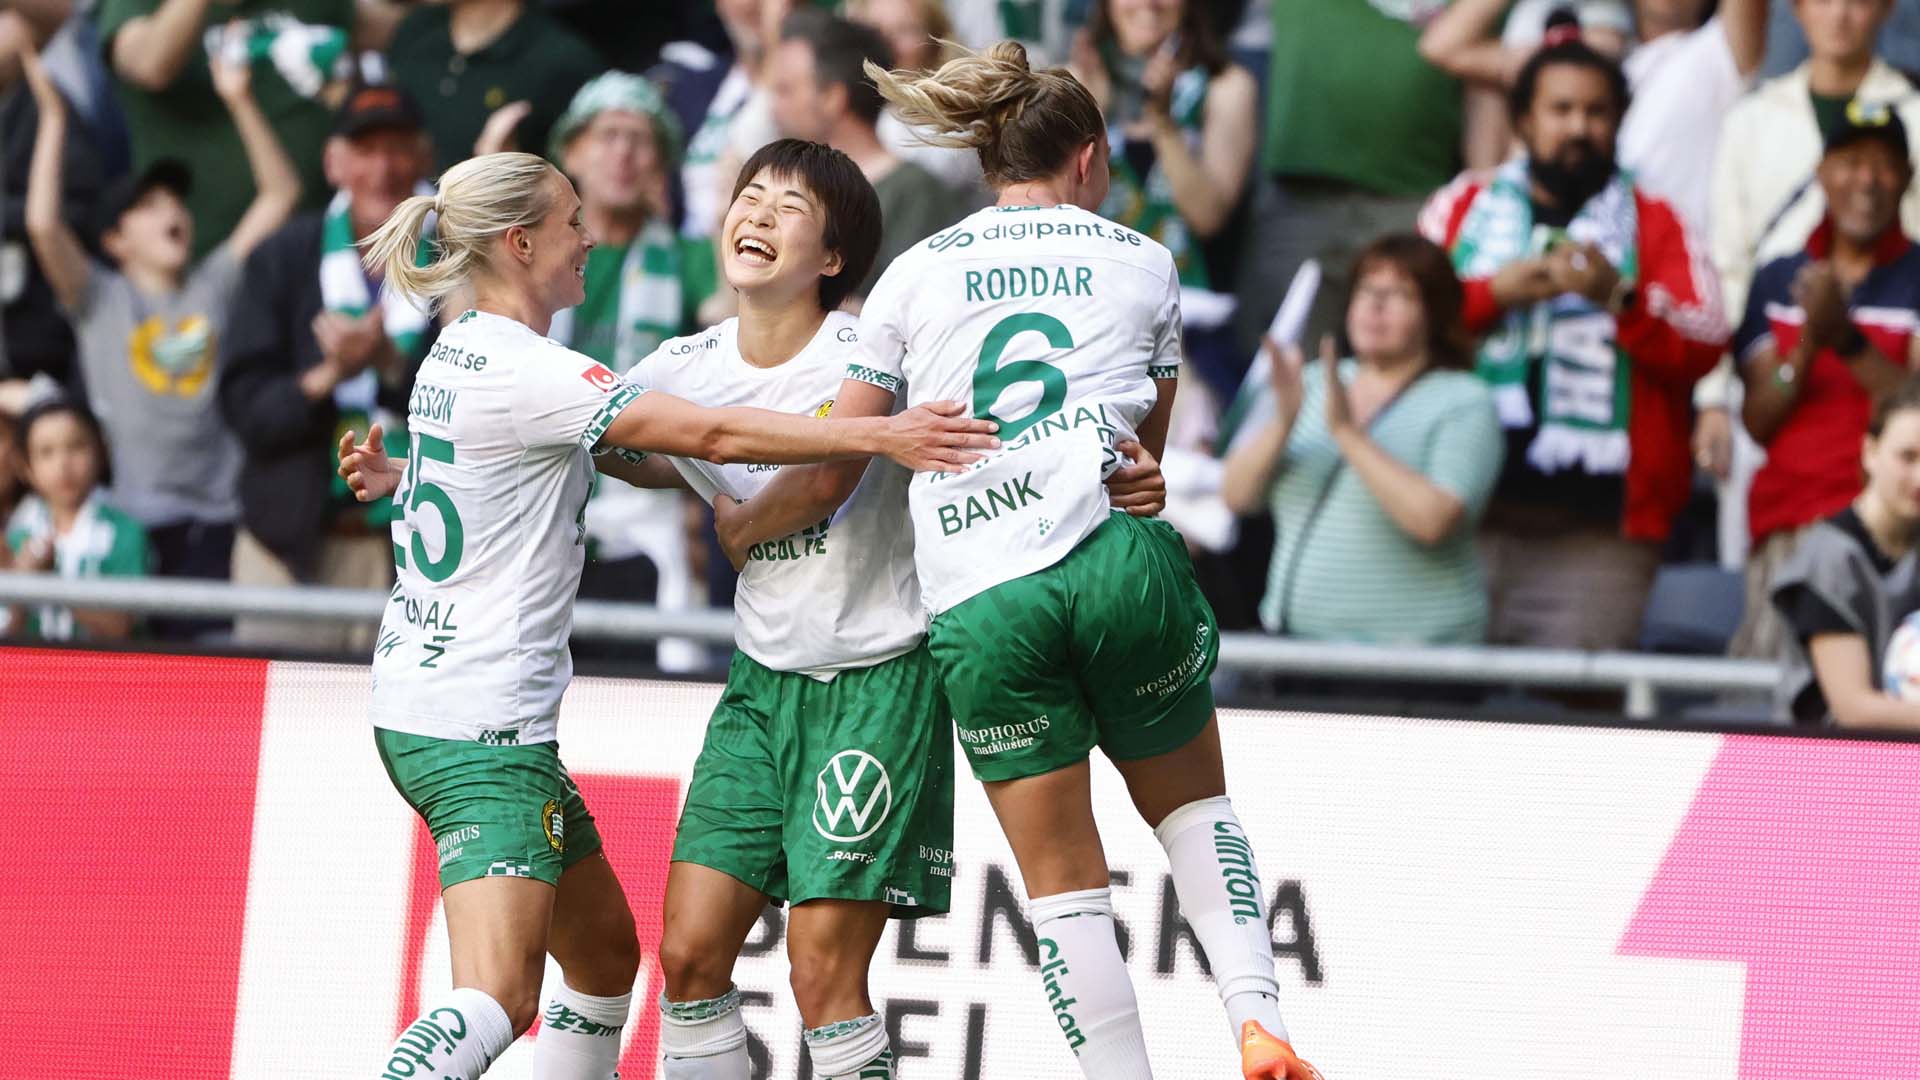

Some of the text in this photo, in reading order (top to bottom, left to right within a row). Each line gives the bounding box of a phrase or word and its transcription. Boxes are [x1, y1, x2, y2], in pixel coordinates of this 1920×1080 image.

[983, 221, 1142, 247] digipant.se
[965, 266, 1094, 302] RODDAR
[427, 341, 487, 372] pant.se
[973, 312, 1075, 441] 6
[938, 471, 1044, 537] BANK
[958, 714, 1051, 744] BOSPHORUS
[973, 736, 1034, 755] matkluster
[919, 844, 954, 864] BOSP
[929, 865, 952, 878] mat
[1214, 821, 1261, 919] Clinton
[1036, 937, 1087, 1050] Clinton
